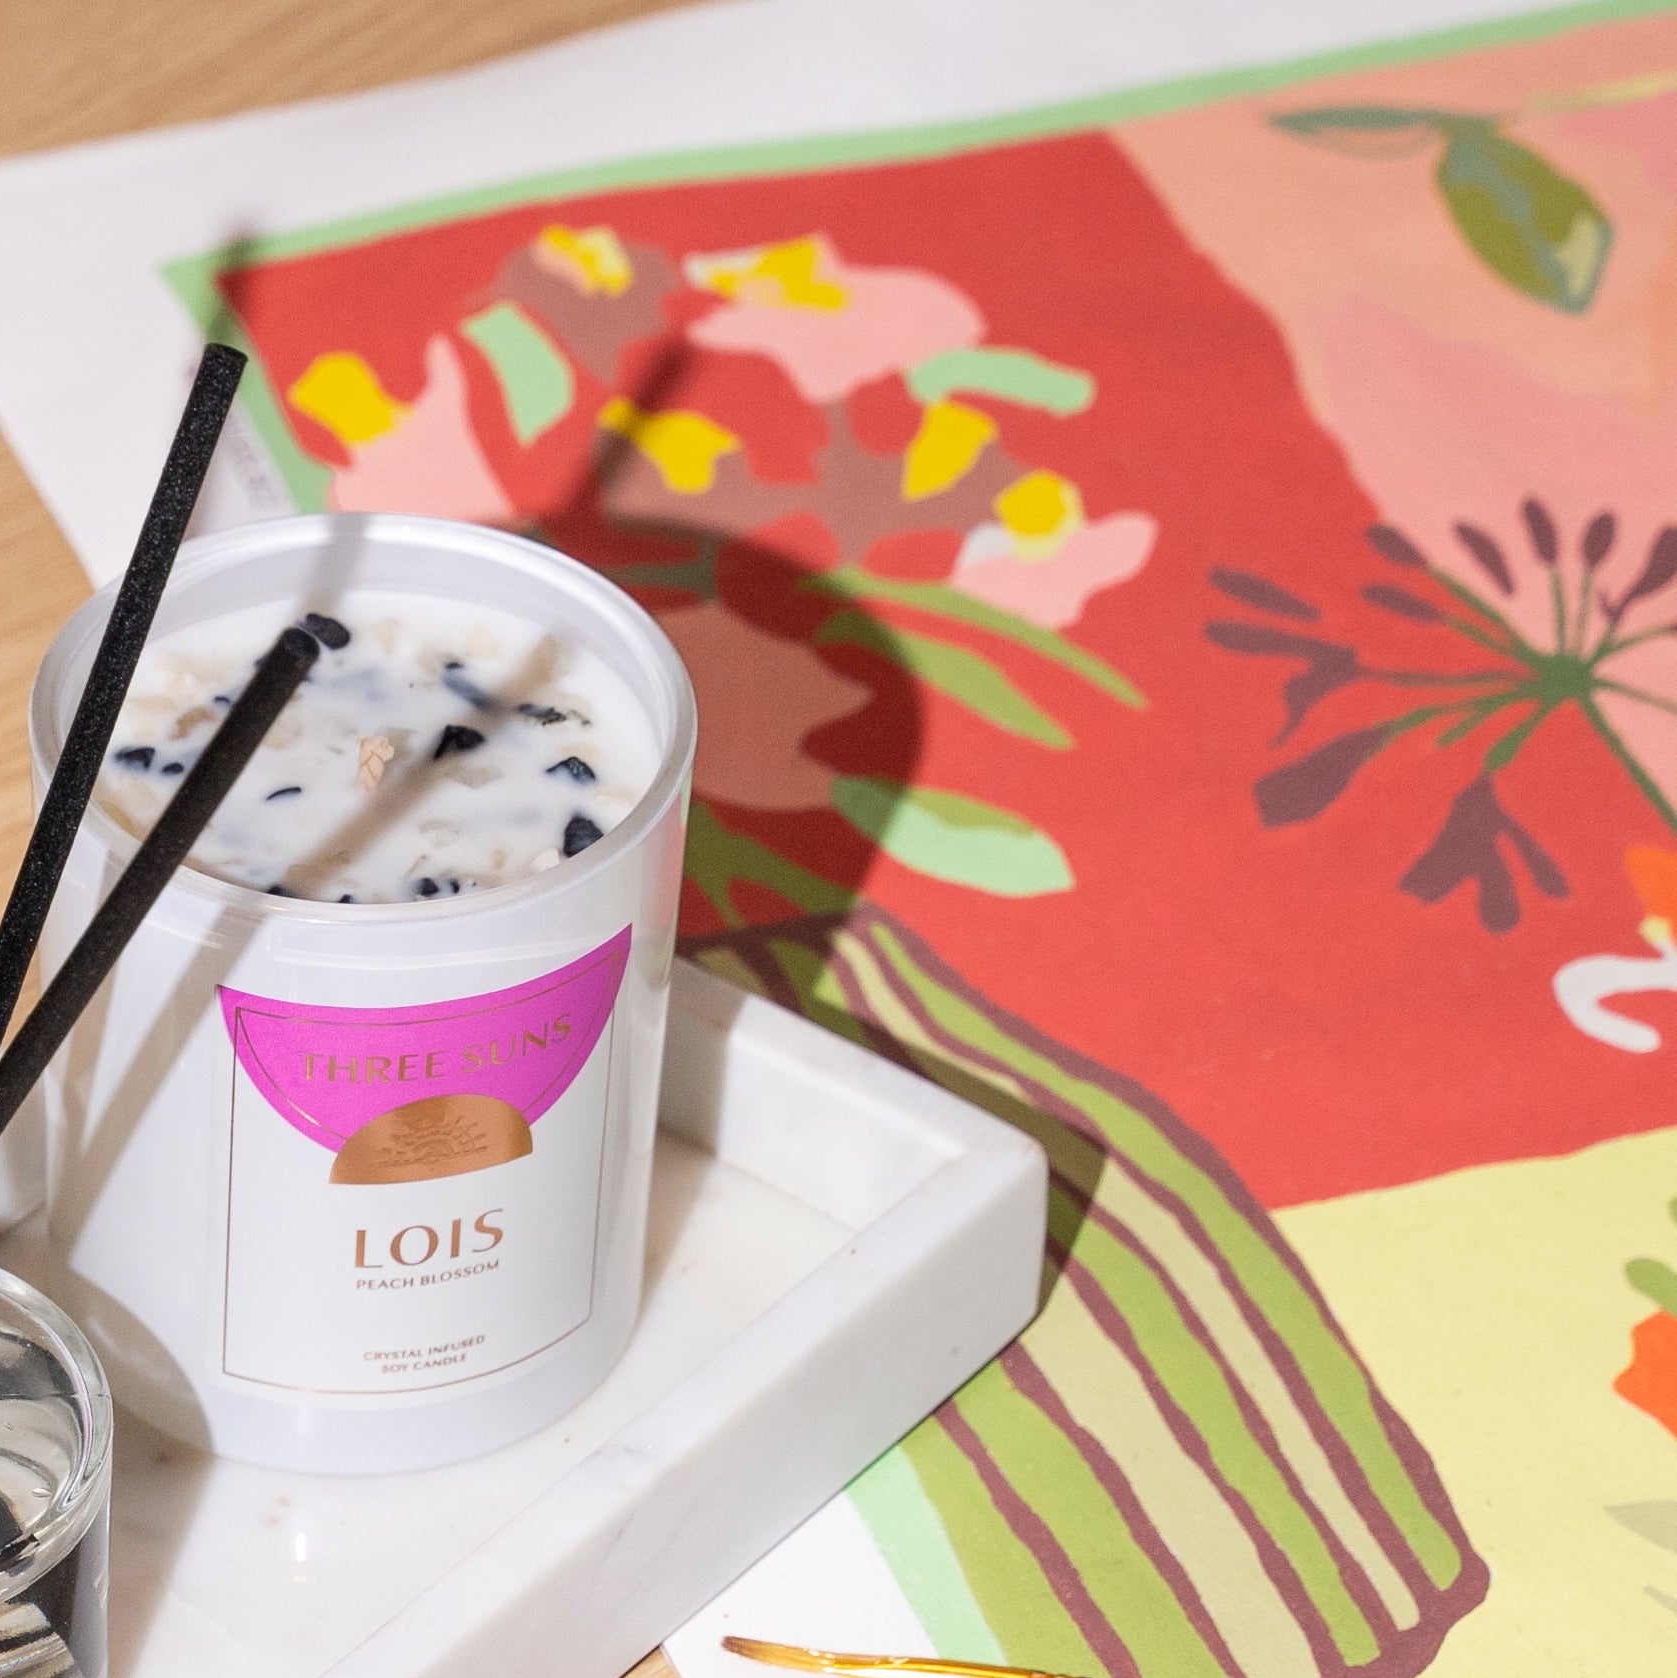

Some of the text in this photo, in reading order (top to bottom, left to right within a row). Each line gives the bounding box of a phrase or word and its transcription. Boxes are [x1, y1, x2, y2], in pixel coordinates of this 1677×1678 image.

[301, 1012, 572, 1084] THREE SUNS
[355, 1208, 504, 1268] LOIS
[356, 1258, 500, 1290] PEACH BLOSSOM
[363, 1334, 486, 1361] CRYSTAL INFUSED
[381, 1352, 467, 1374] SOY CANDLE
